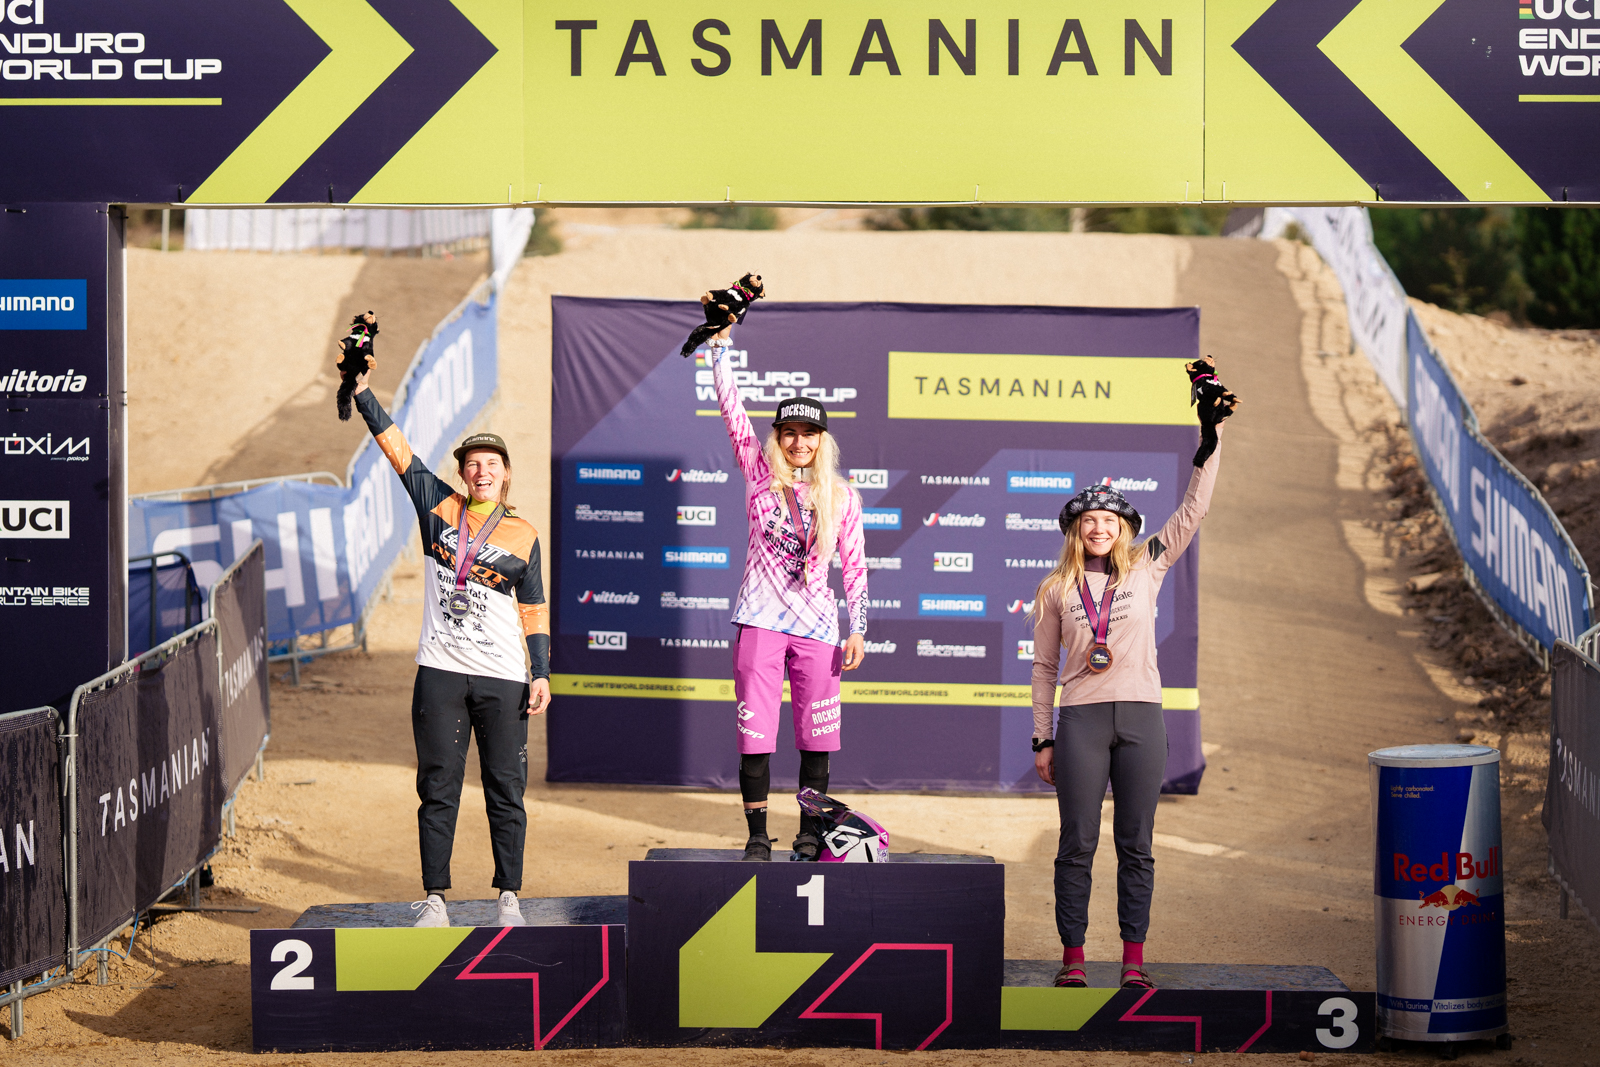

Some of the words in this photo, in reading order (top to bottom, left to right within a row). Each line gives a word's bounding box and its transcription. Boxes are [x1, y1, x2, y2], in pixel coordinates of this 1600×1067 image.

[0, 0, 44, 24] CI
[554, 18, 1173, 77] TASMANIAN
[0, 59, 123, 80] ORLD
[134, 59, 222, 80] CUP
[1518, 55, 1600, 76] WO
[704, 350, 748, 368] CI
[695, 370, 810, 387] EDURO
[695, 386, 797, 402] WRLD
[914, 376, 1112, 399] TASMANIAN
[780, 403, 821, 421] ROCKSHOX
[578, 467, 641, 481] SHIMANO
[681, 468, 729, 484] vittoria
[857, 474, 884, 485] UCI
[920, 475, 990, 486] TASMANIAN
[1009, 475, 1073, 490] SHIMANO
[2, 507, 63, 532] UCI
[684, 510, 712, 521] UCI
[862, 511, 900, 526] MANO
[937, 512, 986, 527] vittoria
[575, 549, 645, 560] TASMANIAN
[664, 551, 728, 564] SHIMANO
[942, 557, 969, 567] UCI
[1469, 465, 1576, 646] SHIMANO
[1004, 559, 1058, 568] TASMANI
[0, 587, 49, 596] NTAIN
[52, 587, 90, 596] BIKE
[592, 590, 640, 605] vittoria
[31, 597, 90, 606] SERIES
[921, 599, 984, 612] SHIMANO
[595, 635, 623, 647] UCI
[659, 638, 730, 649] TASMANIAN
[99, 727, 211, 837] TASMANIAN
[1393, 851, 1450, 882] Red
[1455, 845, 1499, 880] Bull
[795, 874, 825, 926] 1
[1399, 914, 1456, 927] ENERGY
[1461, 911, 1497, 926] DRINK
[269, 939, 315, 992] 2
[1405, 1000, 1430, 1011] Taurine.
[1434, 1001, 1465, 1011] Vitalizes
[1466, 999, 1484, 1010] body
[1315, 996, 1359, 1049] 3
